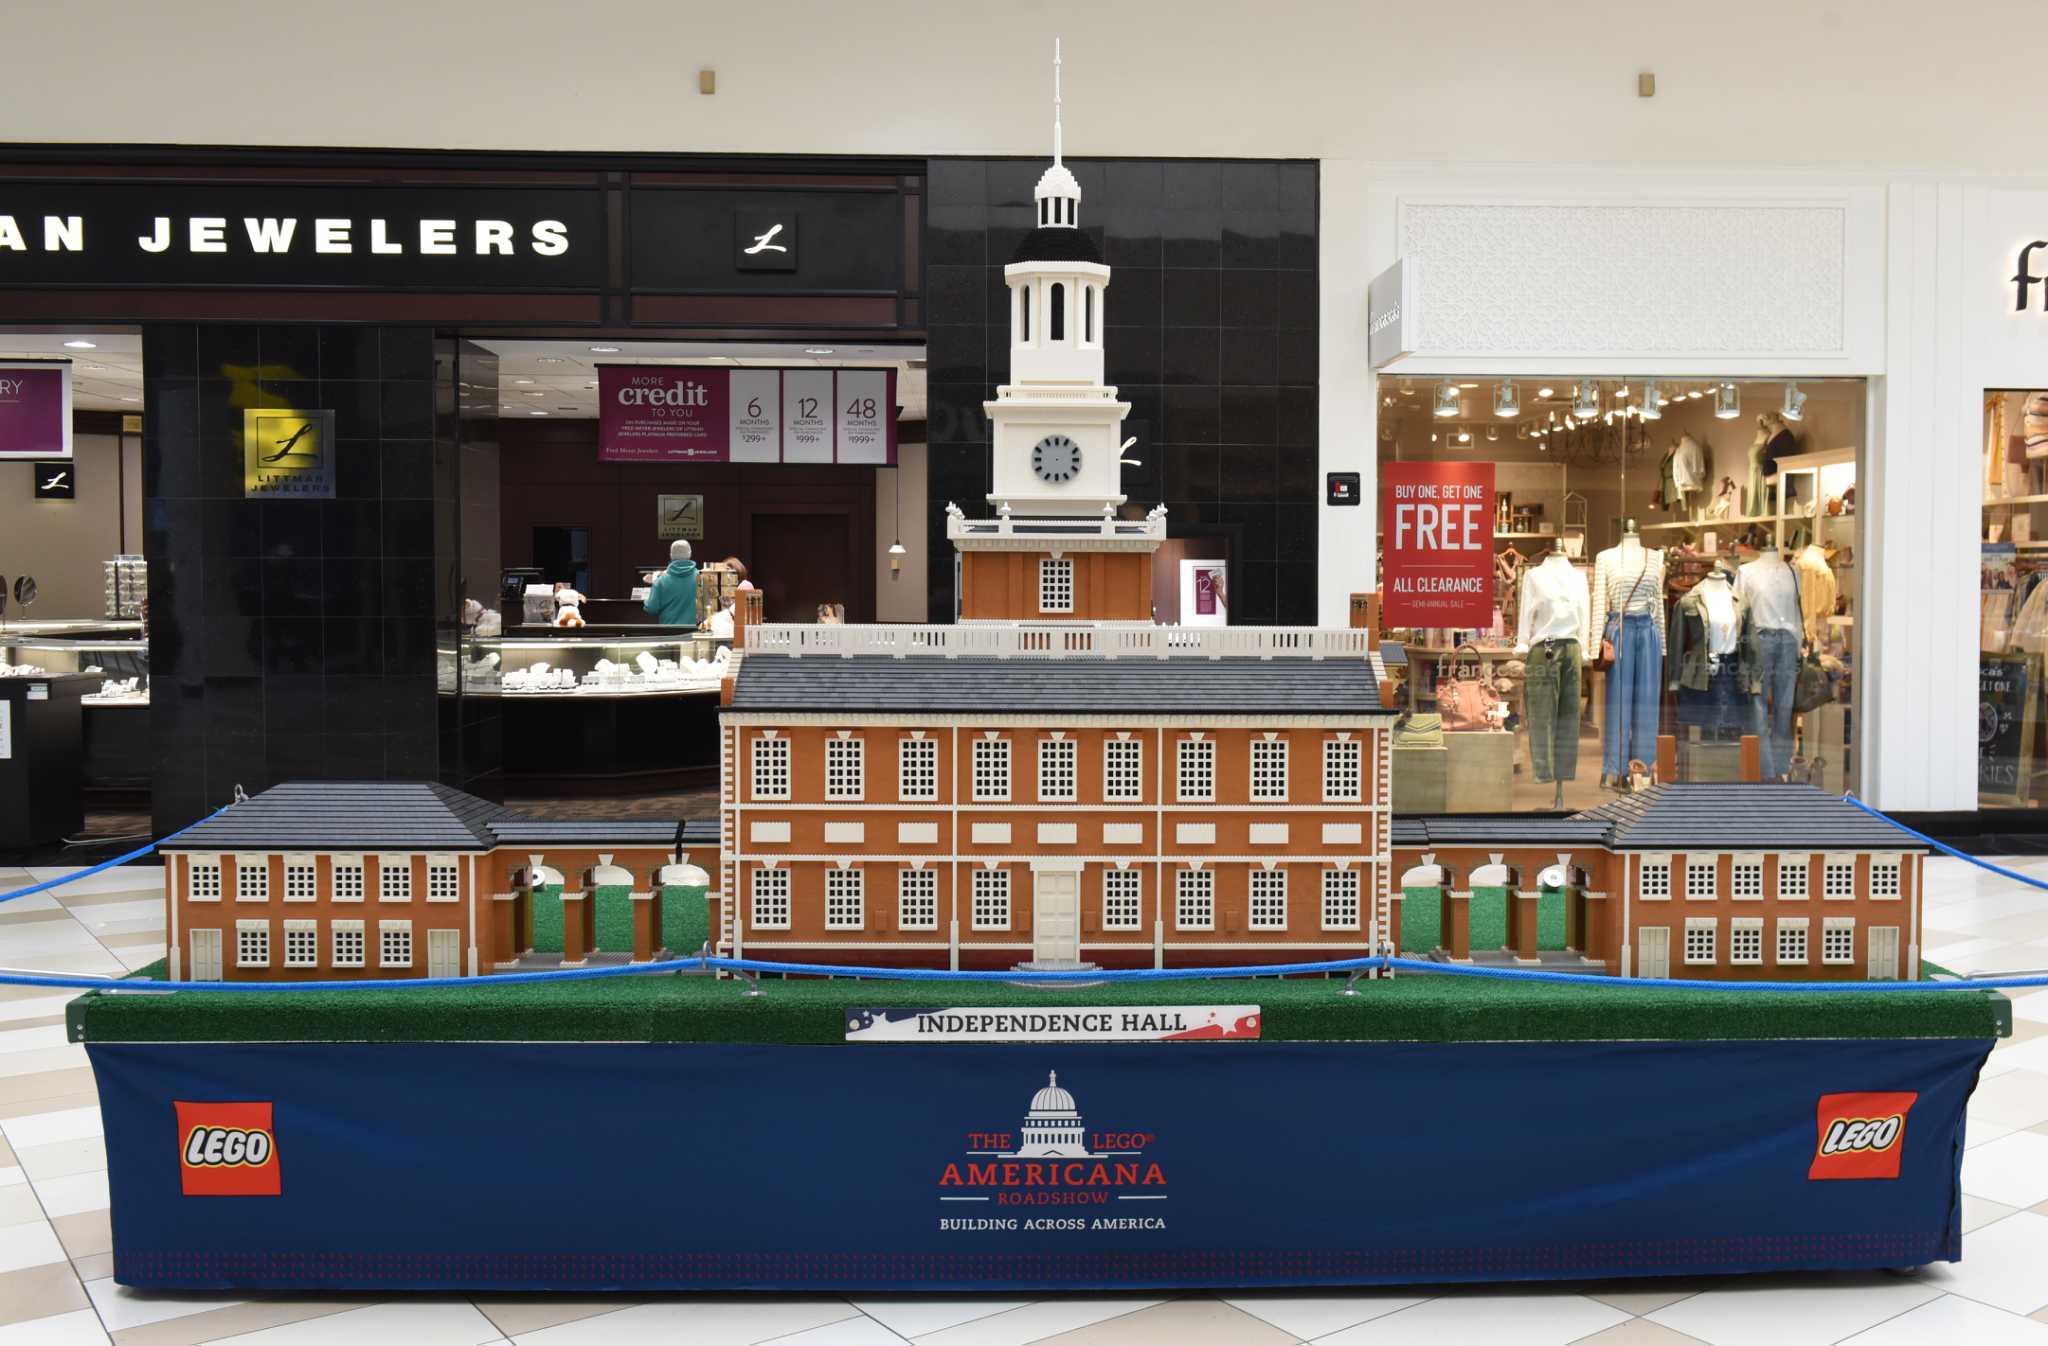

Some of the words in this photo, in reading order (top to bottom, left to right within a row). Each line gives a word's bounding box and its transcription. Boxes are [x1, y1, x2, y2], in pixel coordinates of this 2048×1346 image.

[138, 217, 569, 256] JEWELERS
[2010, 240, 2048, 312] f
[631, 377, 664, 386] MORE
[618, 381, 708, 406] credit
[652, 408, 666, 417] TO
[670, 408, 693, 417] YOU
[747, 397, 762, 418] 6
[798, 398, 818, 418] 12
[846, 398, 876, 419] 48
[1395, 485, 1415, 499] BUY
[1418, 485, 1440, 500] ONE,
[1443, 485, 1461, 499] GET
[1464, 485, 1483, 499] ONE
[1395, 503, 1483, 550] FREE
[1196, 577, 1211, 593] 12
[1393, 578, 1414, 593] ALL
[1417, 578, 1483, 593] CLEARANCE
[917, 1014, 1112, 1033] INDEPENDENCE
[1122, 1013, 1187, 1031] HALL
[968, 1133, 1011, 1149] THE
[1821, 1115, 1902, 1155] LEGO
[185, 1127, 270, 1166] LEGO
[939, 1163, 1167, 1185] AMERICANA
[998, 1191, 1109, 1205] ROADSHOW
[940, 1218, 1017, 1230] BUILDING
[1024, 1218, 1086, 1230] ACROSS
[1092, 1217, 1166, 1230] AMERICA
